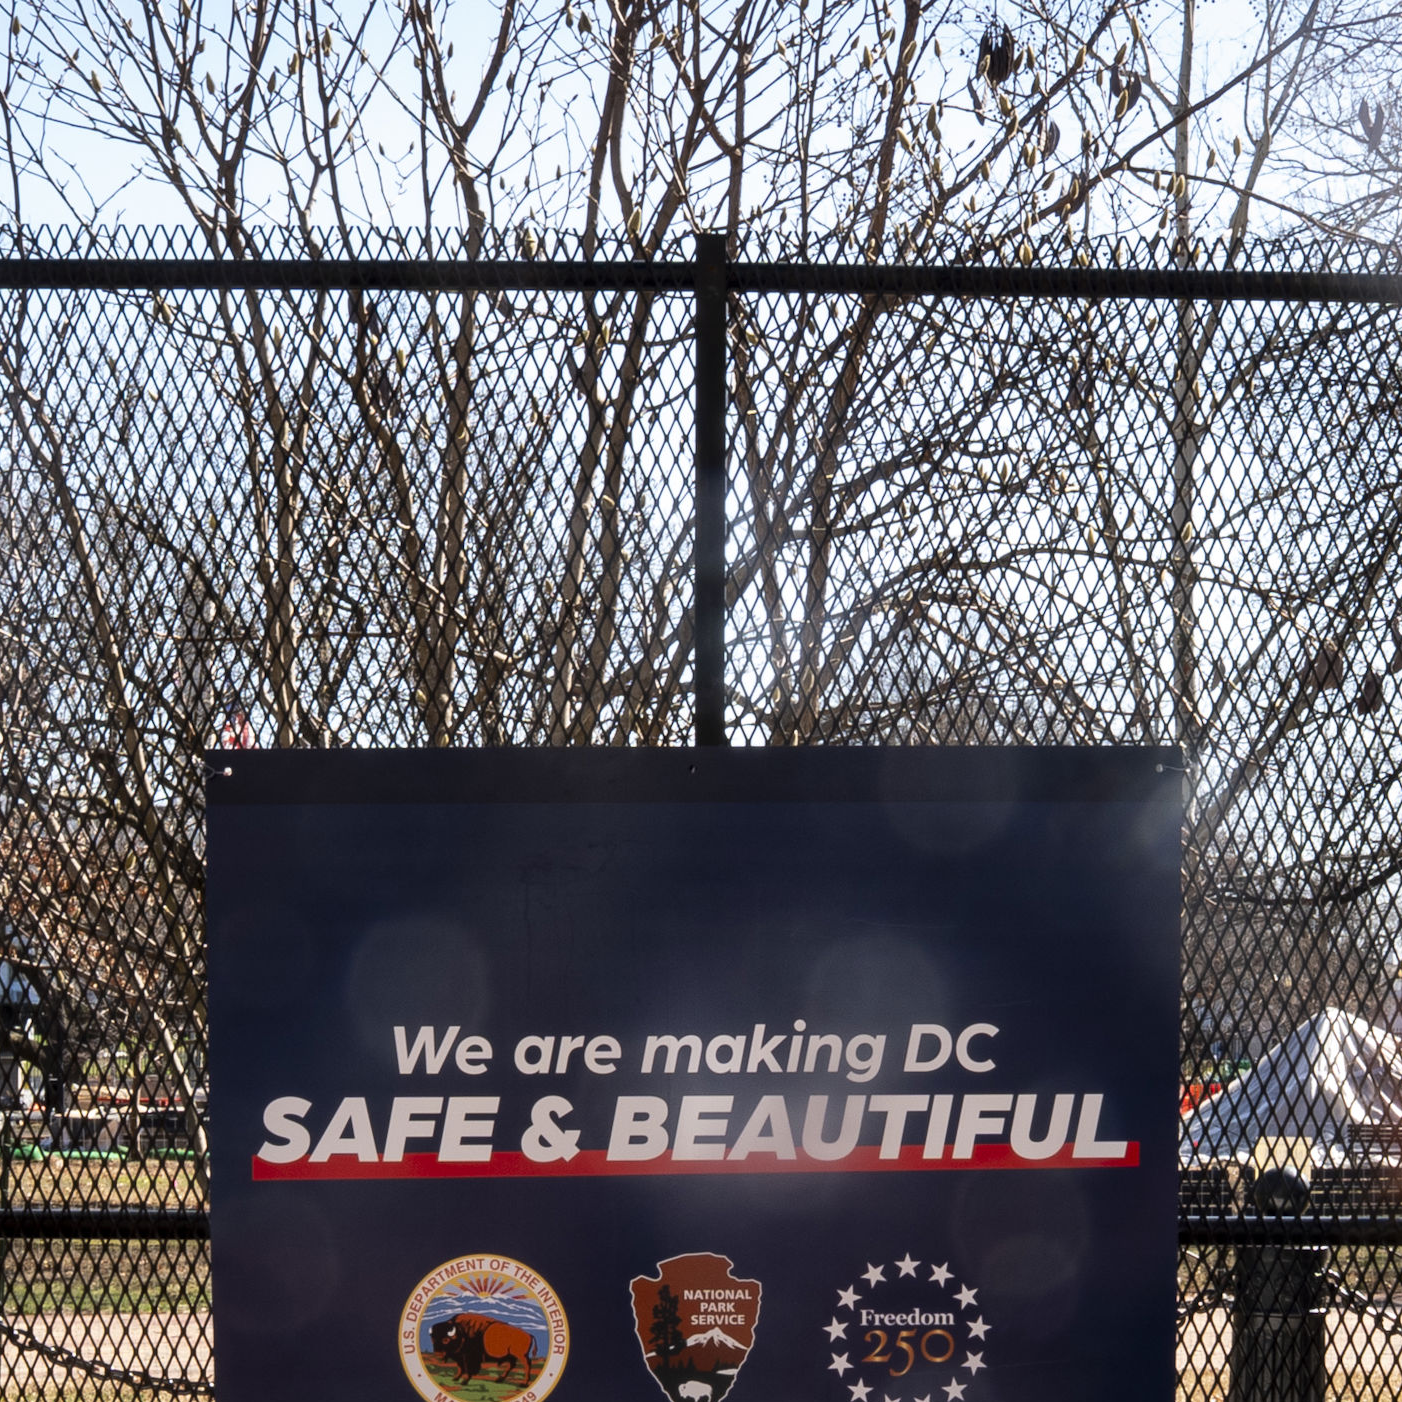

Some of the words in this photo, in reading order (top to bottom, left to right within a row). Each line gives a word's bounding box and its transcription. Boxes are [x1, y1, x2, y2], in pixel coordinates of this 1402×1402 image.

[392, 1025, 493, 1075] We
[514, 1034, 622, 1074] are
[640, 1019, 887, 1084] making
[903, 1023, 1000, 1074] DC
[257, 1094, 500, 1165] SAFE
[520, 1095, 581, 1164] &
[607, 1093, 1129, 1162] BEAUTIFUL
[489, 1258, 510, 1273] OF
[514, 1265, 541, 1291] THE
[405, 1258, 486, 1324] DEPARTMENT
[683, 1289, 752, 1301] NATIONAL
[538, 1287, 565, 1355] INTERIOR
[690, 1314, 746, 1326] SERVICE
[700, 1302, 736, 1314] PARK
[859, 1307, 955, 1327] Freedom
[403, 1326, 416, 1354] U.S.
[861, 1329, 955, 1377] 250
